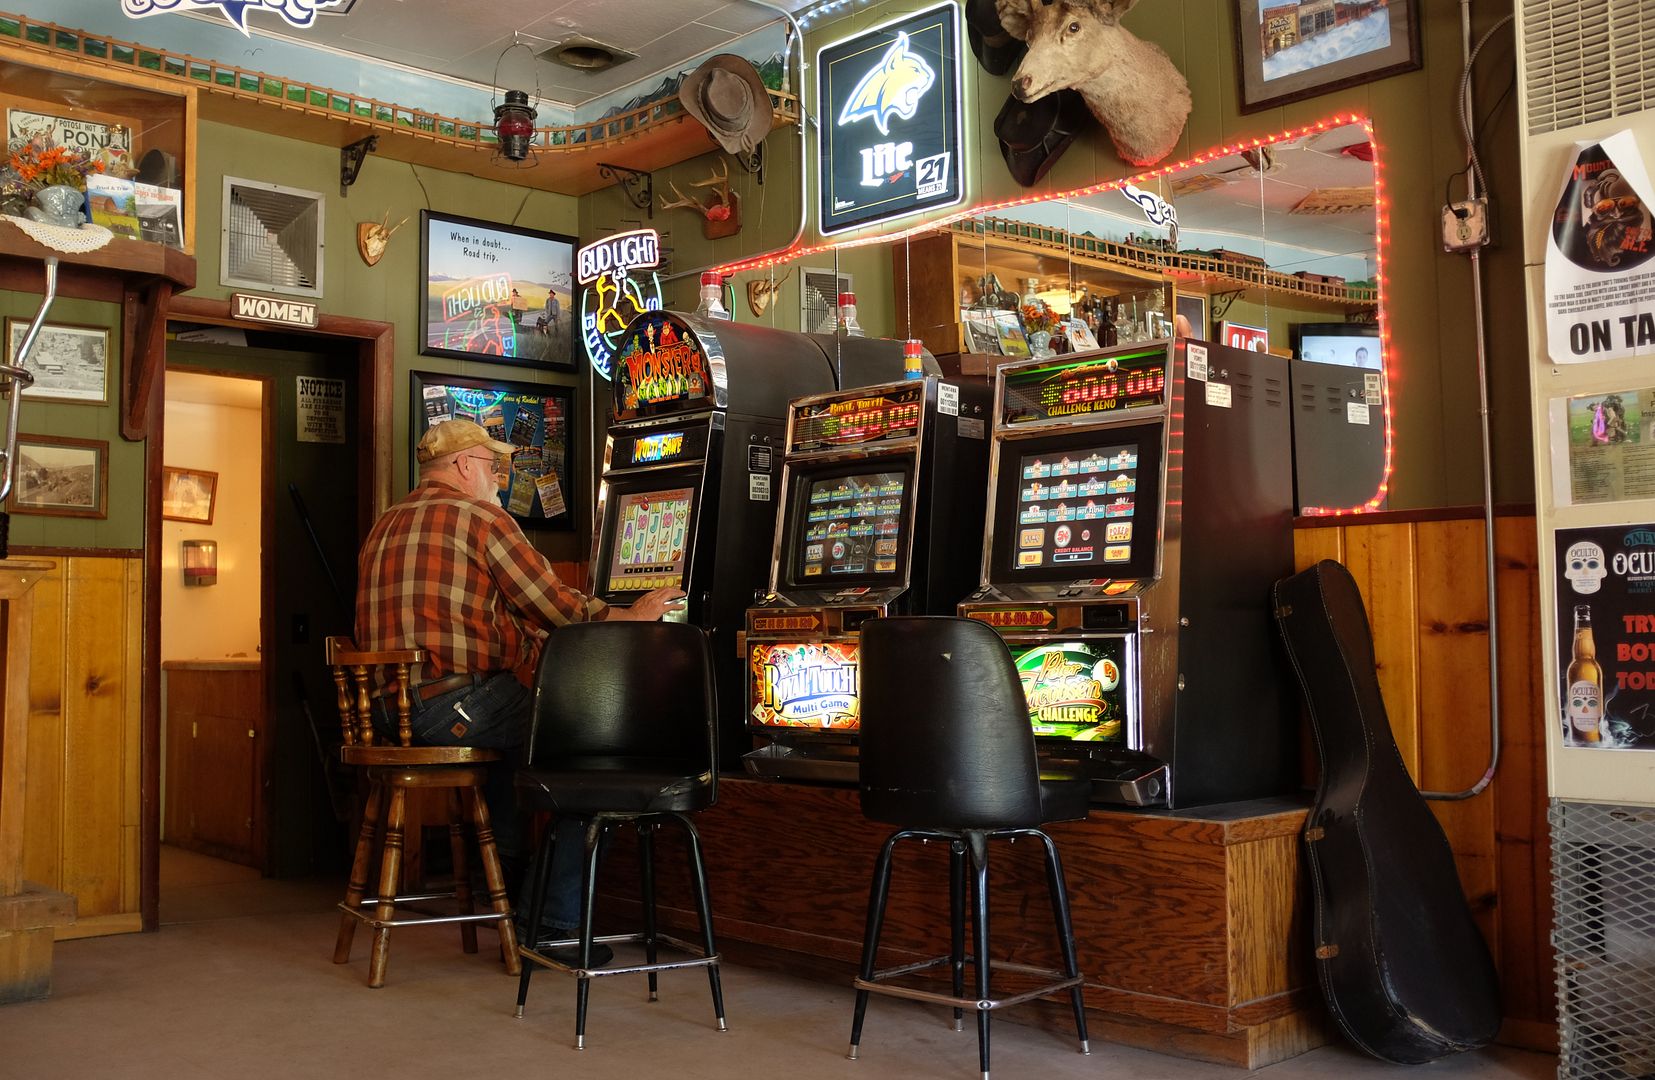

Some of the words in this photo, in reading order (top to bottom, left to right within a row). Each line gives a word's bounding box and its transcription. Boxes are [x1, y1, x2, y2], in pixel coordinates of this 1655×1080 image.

[919, 157, 945, 185] 21
[450, 232, 469, 244] When
[473, 236, 479, 245] in
[463, 247, 480, 258] Road
[484, 250, 499, 262] trip.
[582, 246, 612, 278] BUD
[613, 236, 655, 268] LIGHT
[238, 298, 314, 324] WOMEN
[1570, 319, 1612, 356] ON
[300, 379, 342, 398] NOTICE
[1048, 402, 1092, 416] CHALLENGE
[1094, 400, 1116, 410] KENO
[1571, 548, 1598, 557] OCULTO
[1612, 552, 1655, 575] OCU
[1572, 686, 1598, 696] OCULTO
[793, 704, 817, 714] Multi
[820, 700, 849, 709] Game
[1038, 706, 1099, 722] CHALLENGE
